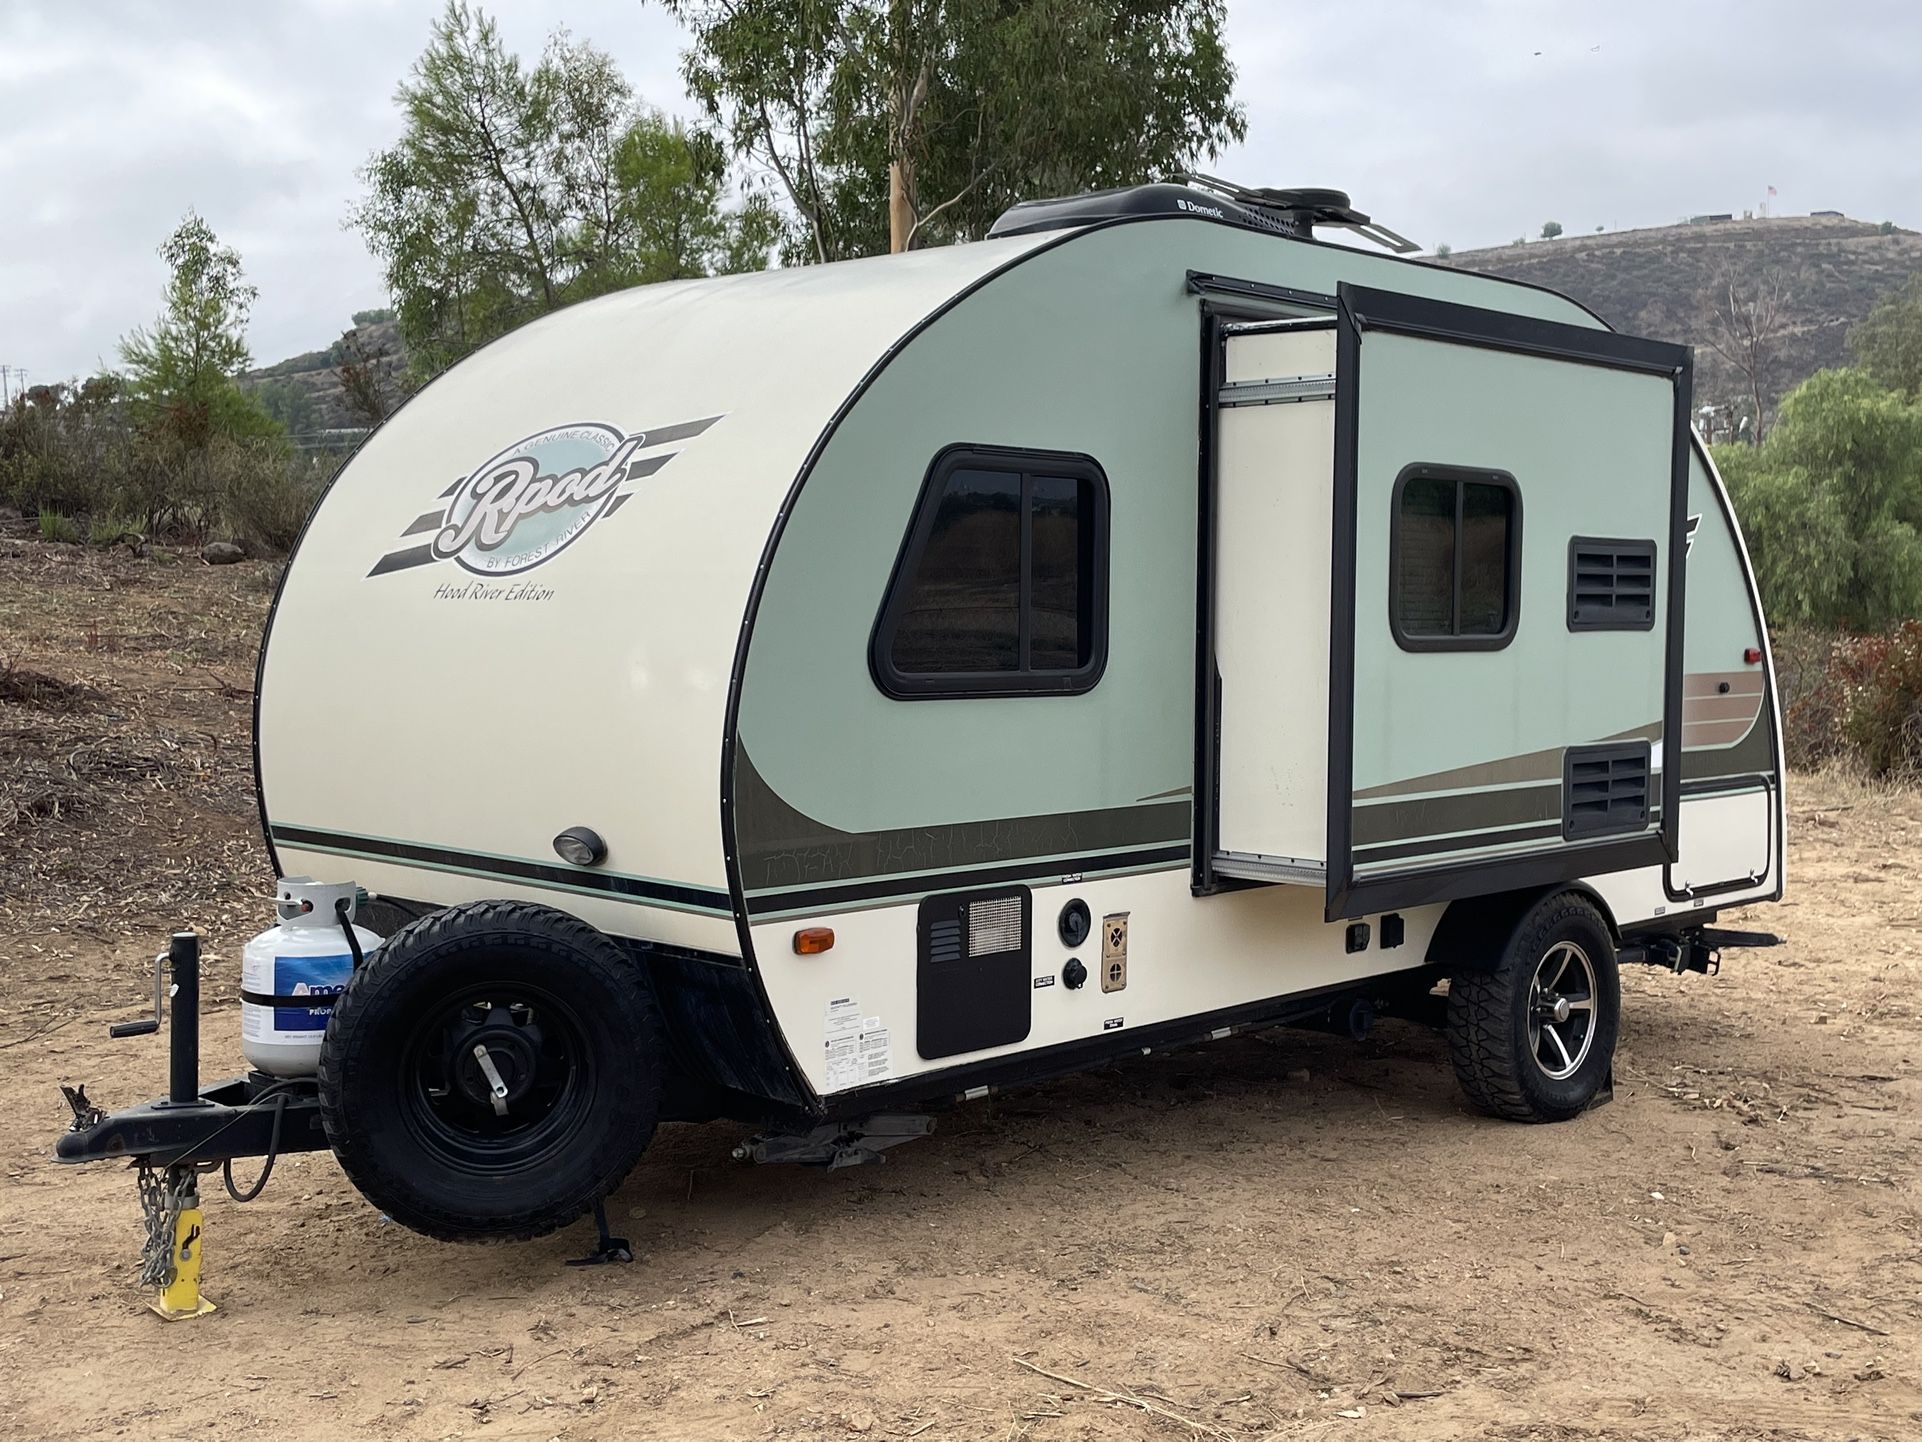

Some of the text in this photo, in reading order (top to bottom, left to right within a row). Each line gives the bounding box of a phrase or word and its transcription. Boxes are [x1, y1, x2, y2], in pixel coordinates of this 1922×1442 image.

[1187, 201, 1224, 218] Dometic
[524, 430, 580, 451] GENUINE
[579, 430, 615, 452] CLASSIC
[432, 434, 644, 559] Rpod
[486, 511, 592, 568] BY FOREST RIVER
[433, 580, 555, 600] Hood River Edition
